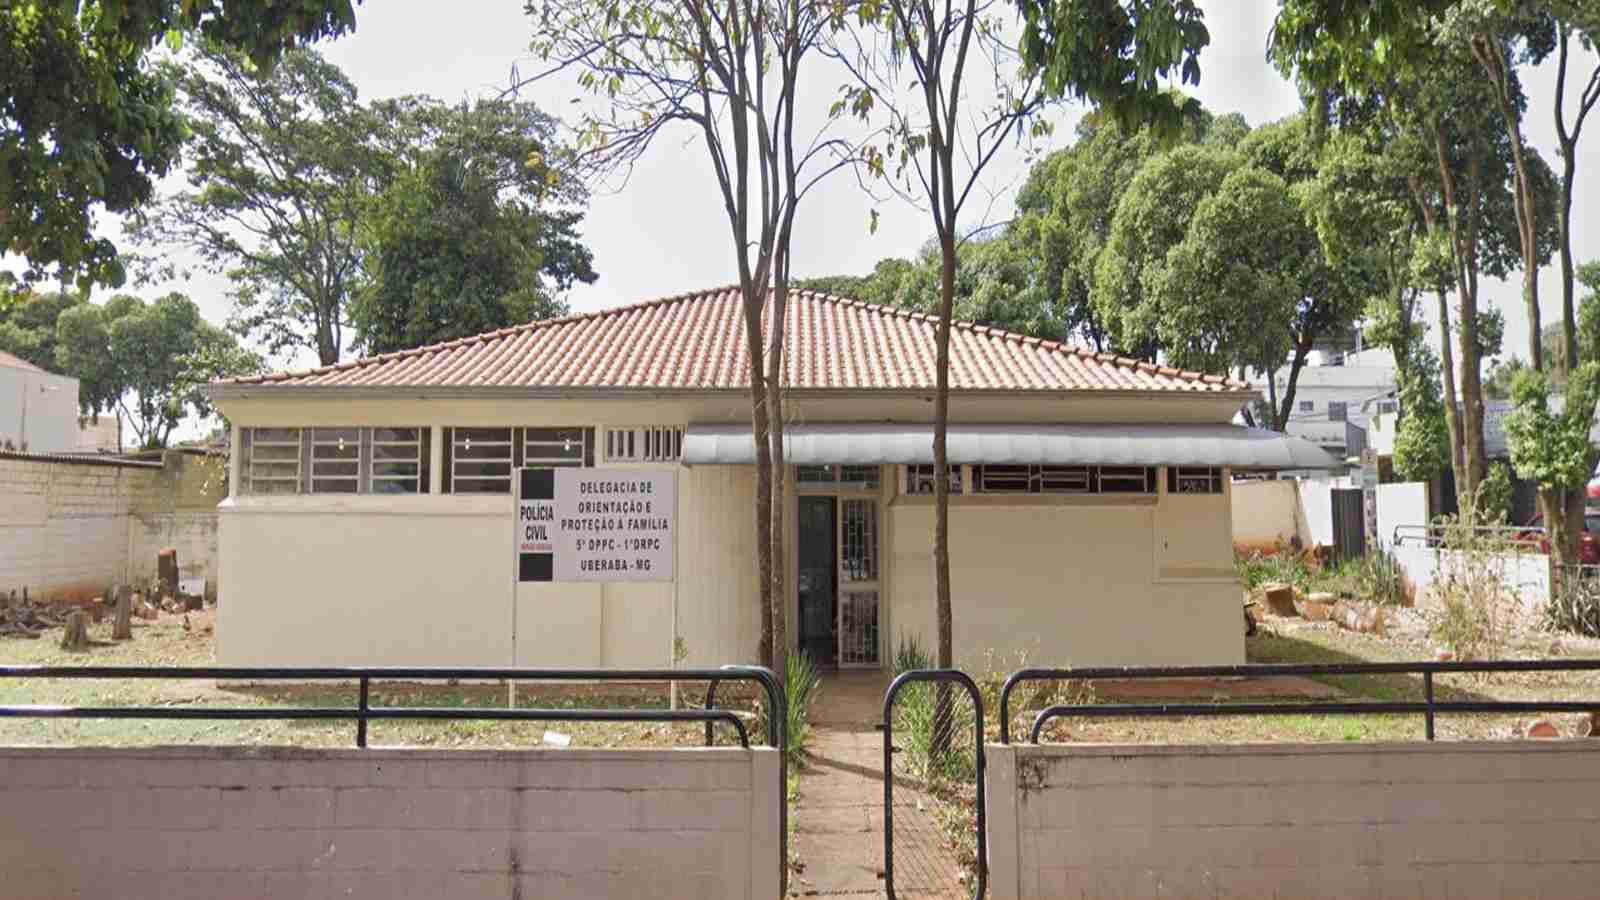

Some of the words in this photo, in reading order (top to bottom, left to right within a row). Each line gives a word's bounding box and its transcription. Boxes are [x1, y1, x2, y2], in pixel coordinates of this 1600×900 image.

[580, 481, 636, 494] DELEGACIA
[639, 481, 652, 494] DE
[520, 503, 554, 521] POLÍCIA
[578, 500, 643, 514] ORIENTAÇÃO
[645, 502, 651, 513] E
[561, 517, 615, 531] PROTEÇÃO
[628, 518, 669, 531] FAMÍLIA
[525, 525, 548, 541] CIVIL
[588, 539, 614, 550] DPPC
[580, 559, 628, 571] UBERABA
[636, 559, 651, 571] MG
